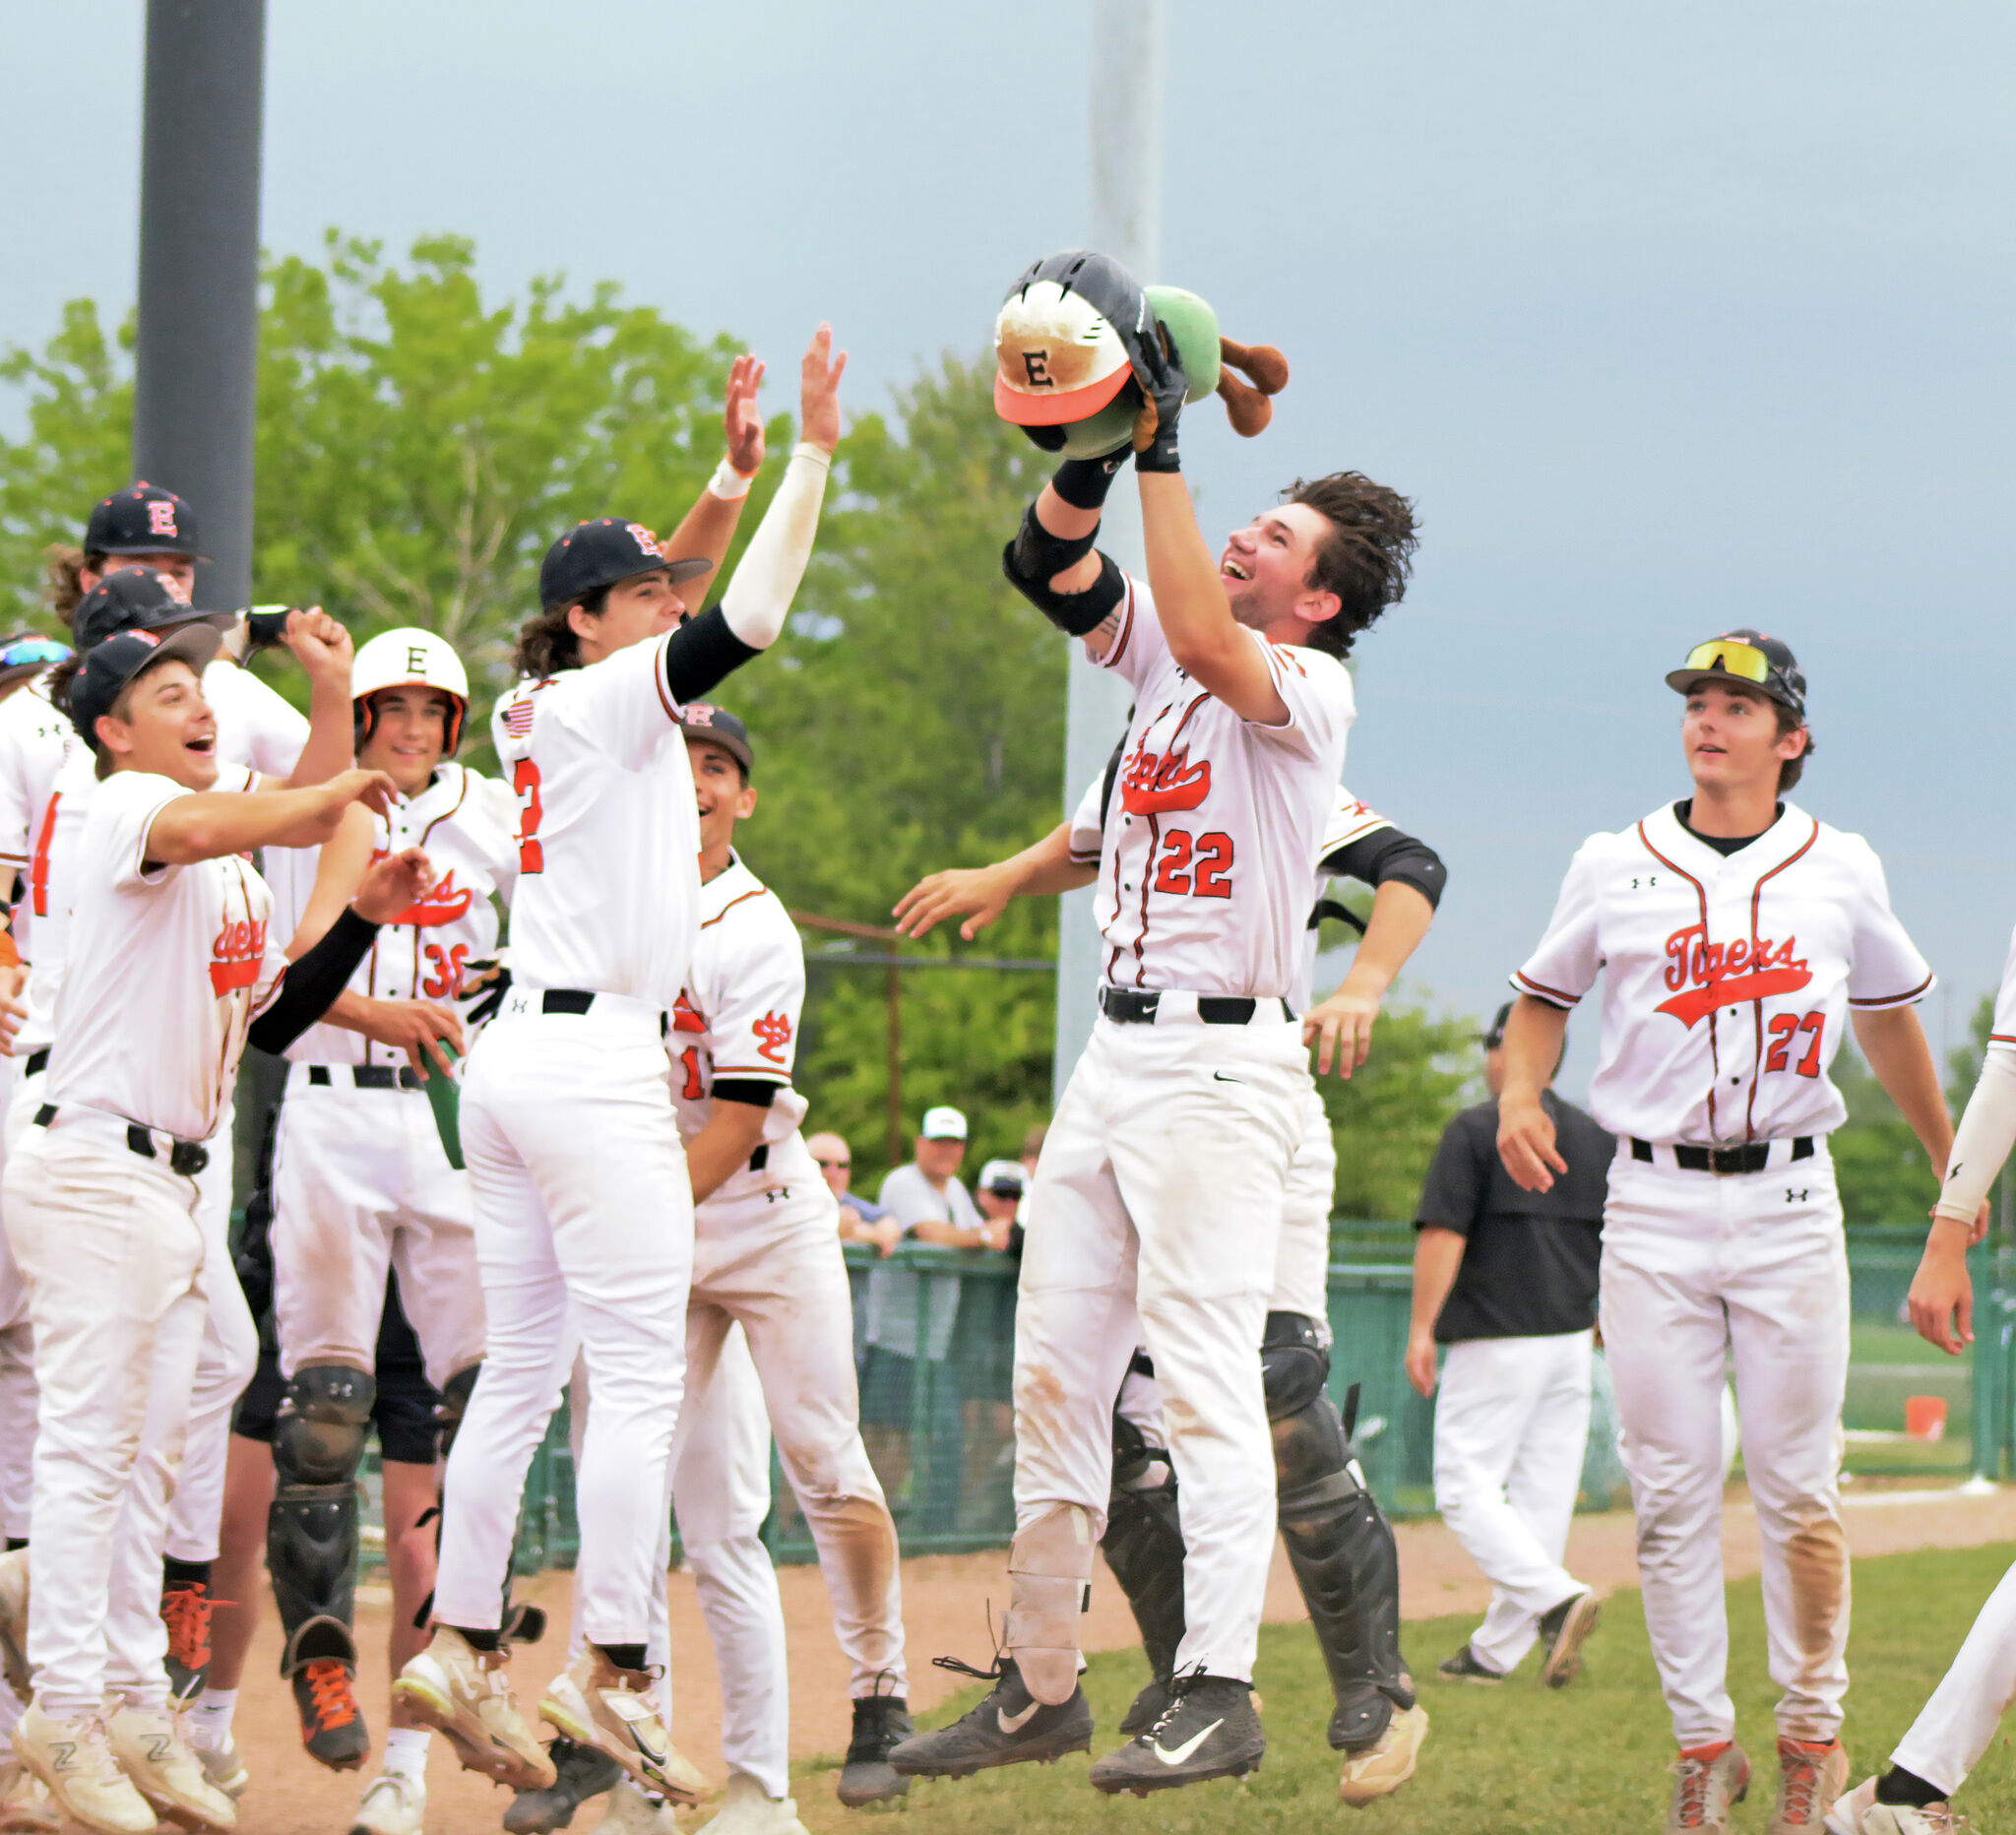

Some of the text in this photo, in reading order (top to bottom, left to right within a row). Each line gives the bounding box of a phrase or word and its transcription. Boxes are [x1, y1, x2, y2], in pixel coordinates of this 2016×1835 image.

[1021, 349, 1054, 388] E
[148, 500, 178, 538] E
[406, 646, 427, 676] E
[1154, 828, 1234, 900] 22
[1664, 919, 1809, 996] Tigers
[1764, 1010, 1827, 1079] 27
